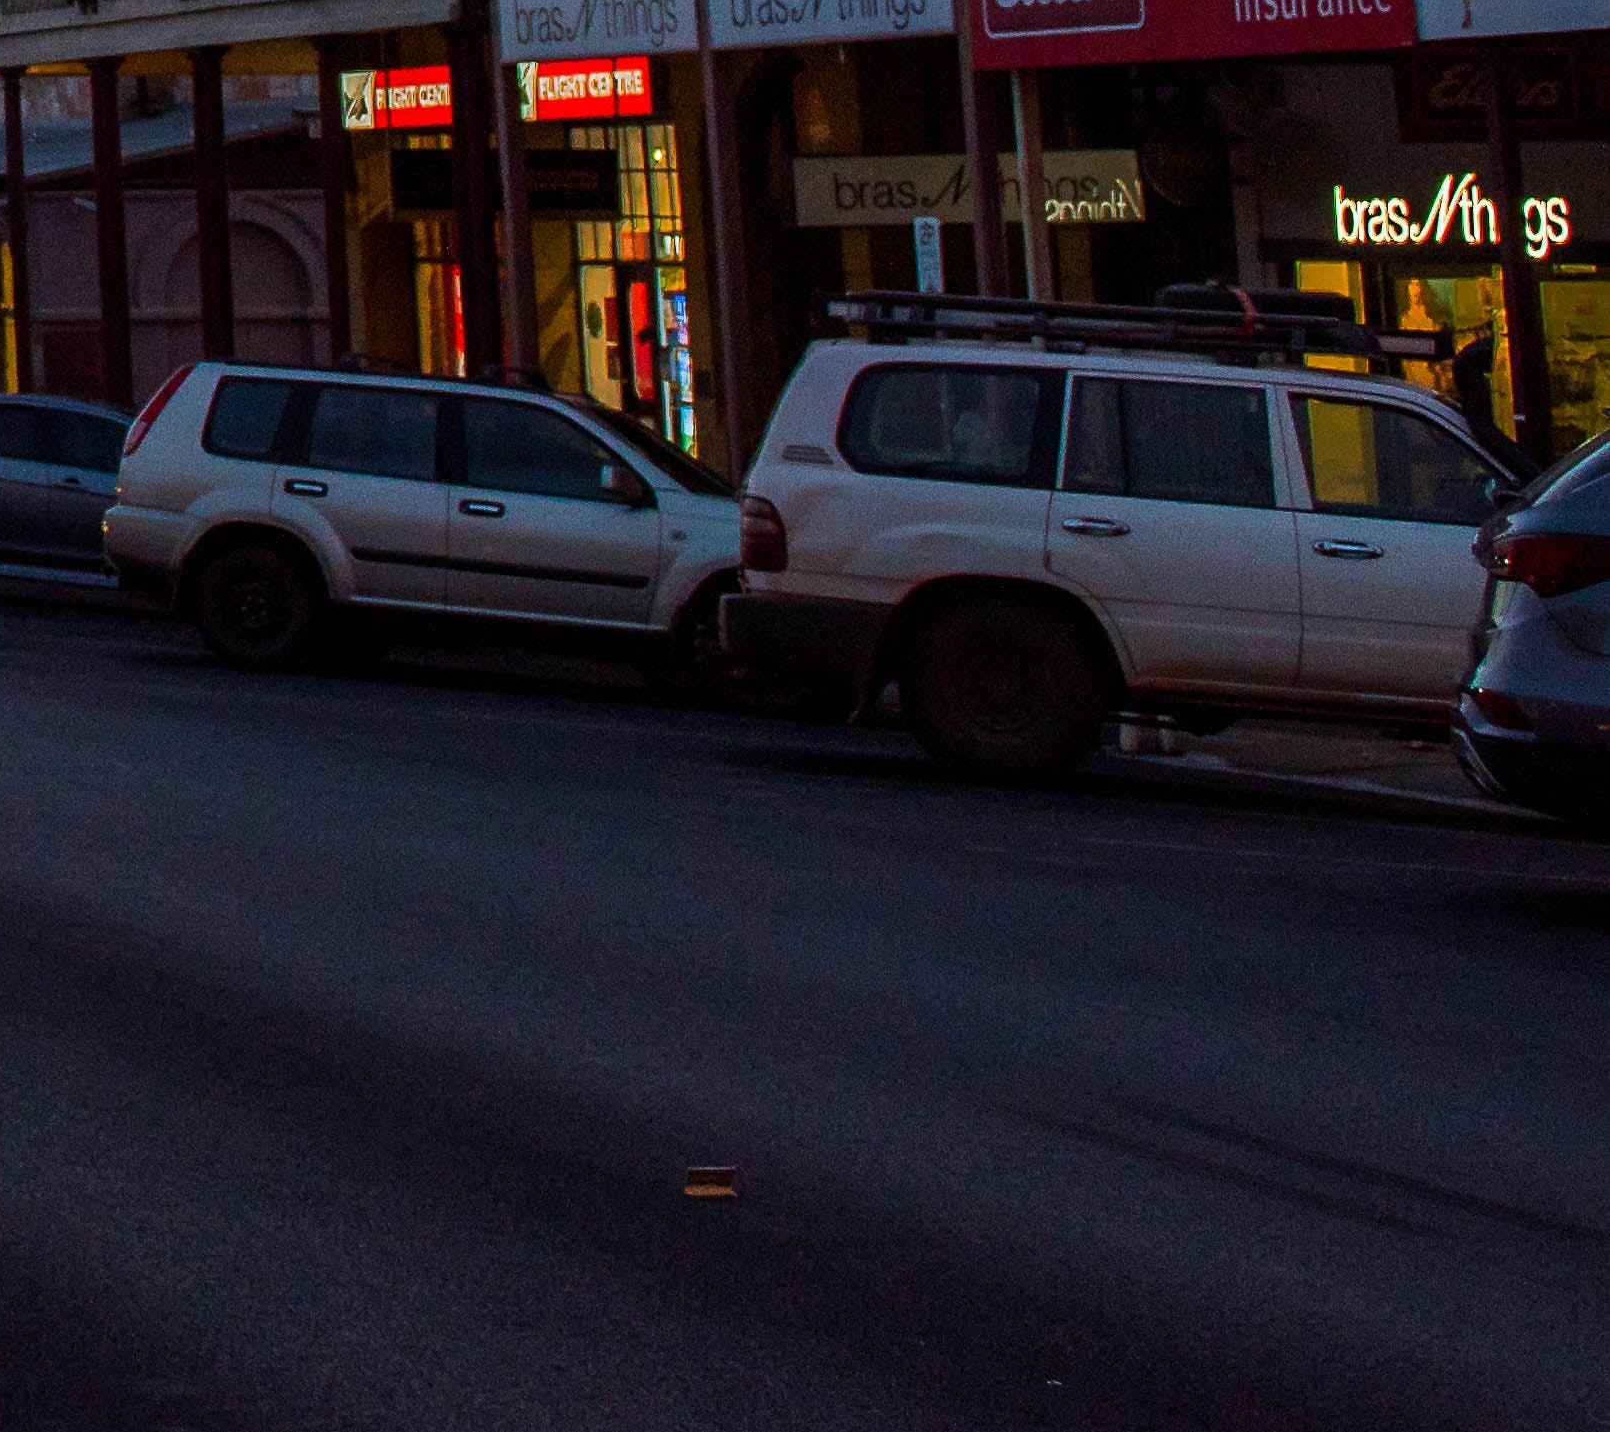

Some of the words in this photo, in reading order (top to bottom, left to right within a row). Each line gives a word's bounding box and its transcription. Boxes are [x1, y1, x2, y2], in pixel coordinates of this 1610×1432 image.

[375, 85, 417, 110] FIGHT
[538, 73, 587, 101] FLIGHT
[834, 172, 916, 210] bras
[1334, 184, 1410, 245] bras
[1458, 184, 1571, 261] thgs
